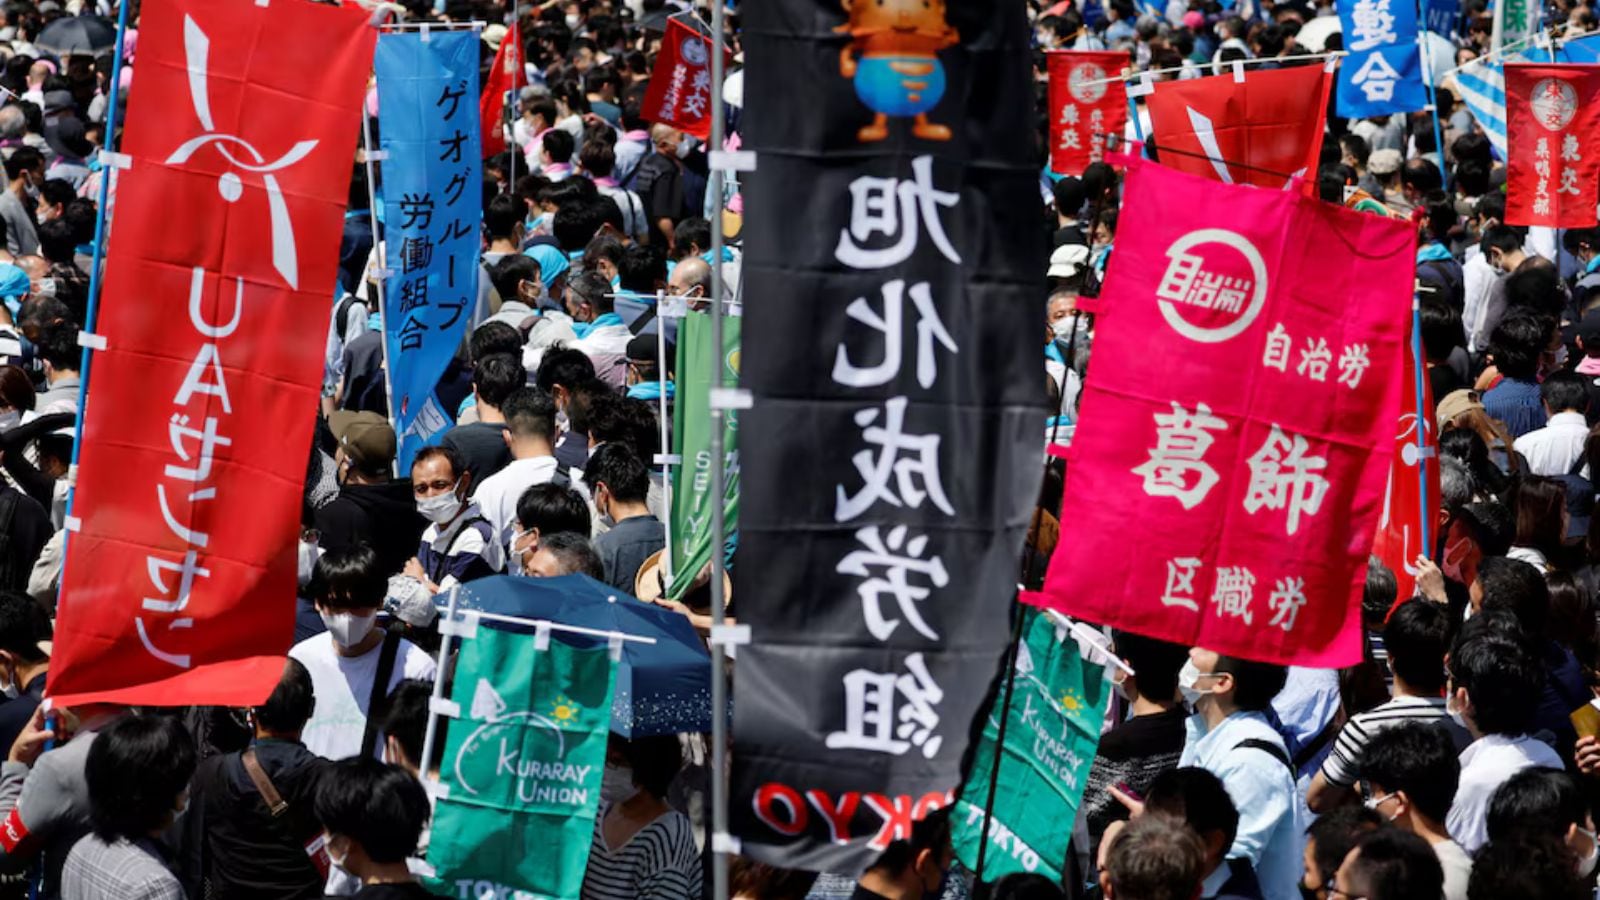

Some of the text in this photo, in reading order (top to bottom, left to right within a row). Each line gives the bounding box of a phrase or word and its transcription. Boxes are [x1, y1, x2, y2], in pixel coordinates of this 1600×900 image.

[436, 80, 471, 330] ゲオグループ
[1556, 133, 1581, 195] 東交
[398, 192, 434, 353] 労働組合
[1262, 322, 1370, 390] 自治労
[1130, 400, 1331, 536] 葛飾
[1160, 557, 1307, 632] 区職労
